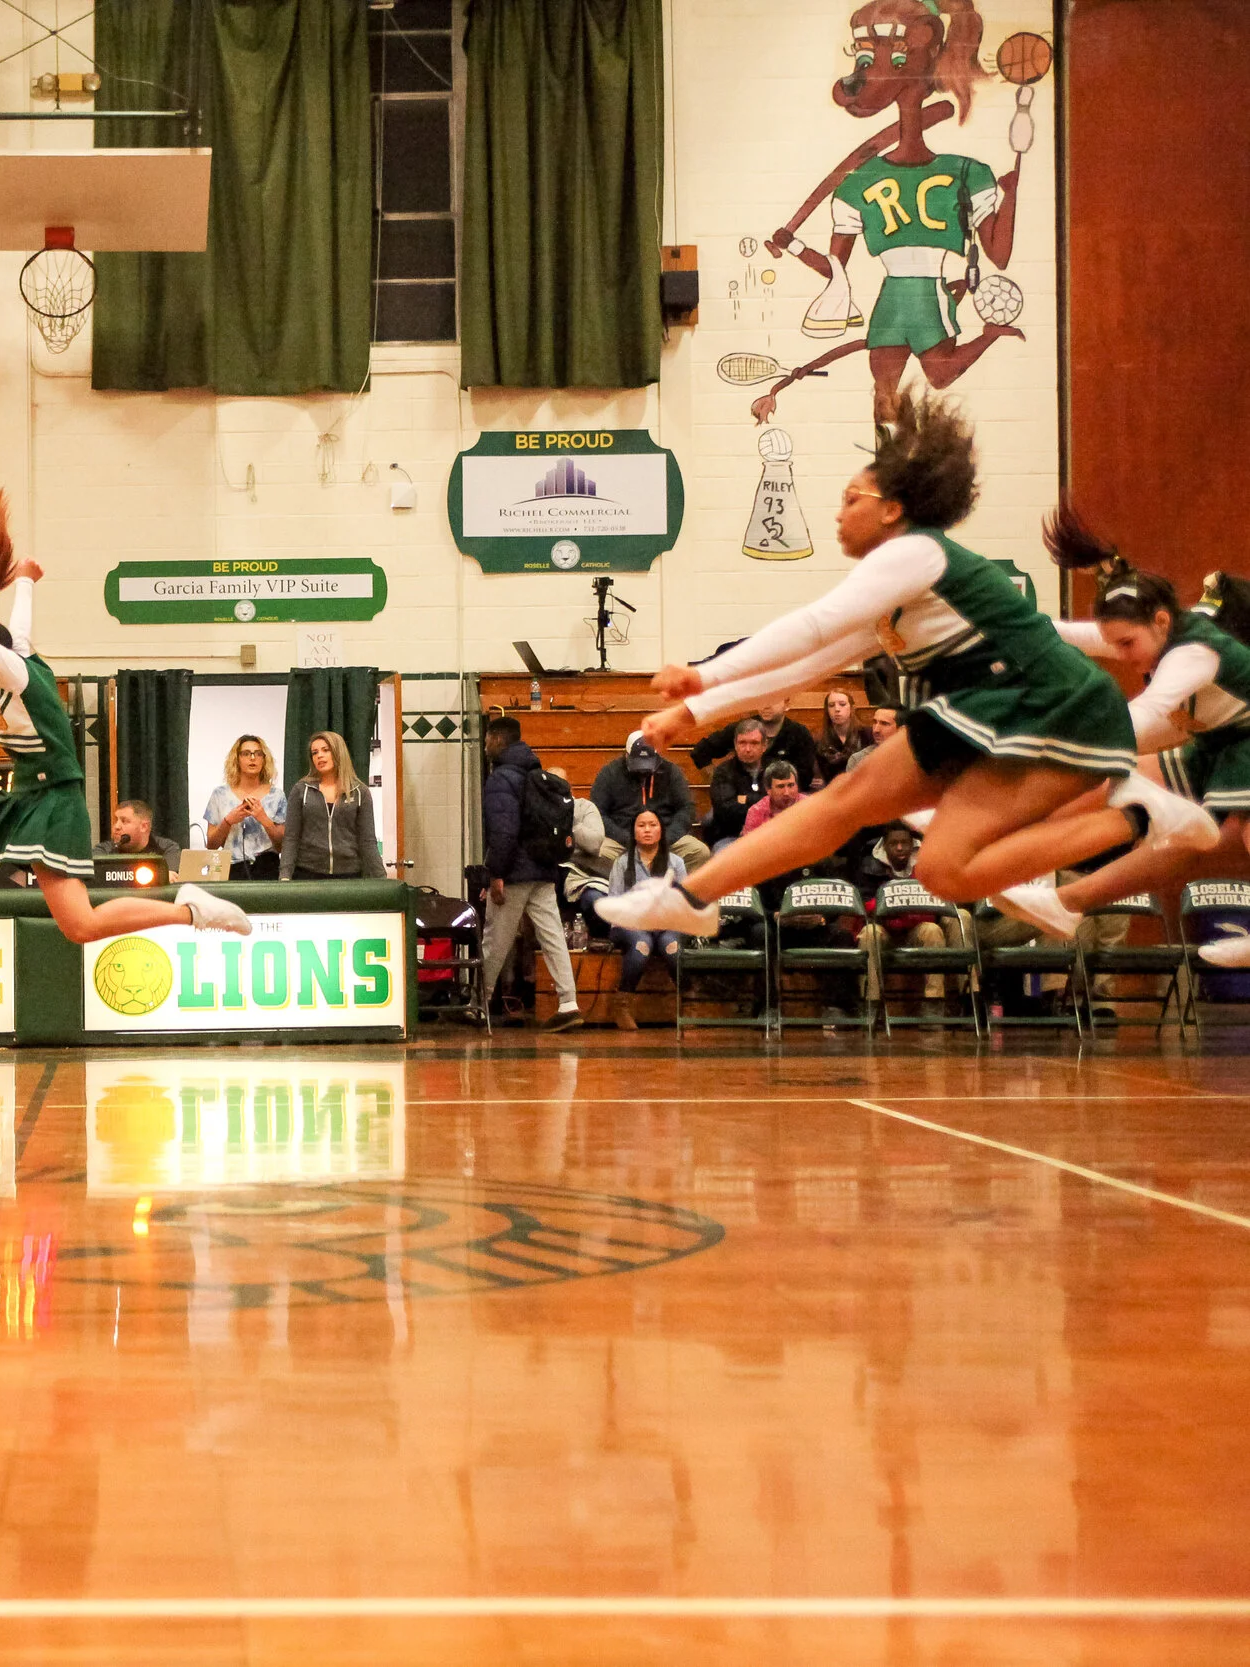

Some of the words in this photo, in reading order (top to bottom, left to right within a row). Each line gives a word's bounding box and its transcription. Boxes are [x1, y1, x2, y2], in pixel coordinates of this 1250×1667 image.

[862, 173, 954, 236] RC
[515, 433, 540, 449] BE
[545, 432, 614, 449] PROUD
[763, 480, 793, 492] RILEY
[763, 496, 784, 515] 93
[213, 562, 230, 573] BE
[233, 561, 279, 573] PROUD
[153, 580, 204, 596] Garcia
[209, 579, 262, 598] Family
[266, 578, 296, 594] VIP
[301, 578, 339, 594] Suite
[306, 633, 336, 643] NOT
[311, 645, 331, 654] AN
[105, 871, 135, 882] BONUS
[791, 884, 853, 896] ROSELLE
[883, 884, 931, 897] ROSEL
[1189, 883, 1250, 896] ROSELLE
[791, 895, 853, 907] CATHOLIC
[259, 922, 283, 932] THE
[176, 937, 392, 1009] LIONS
